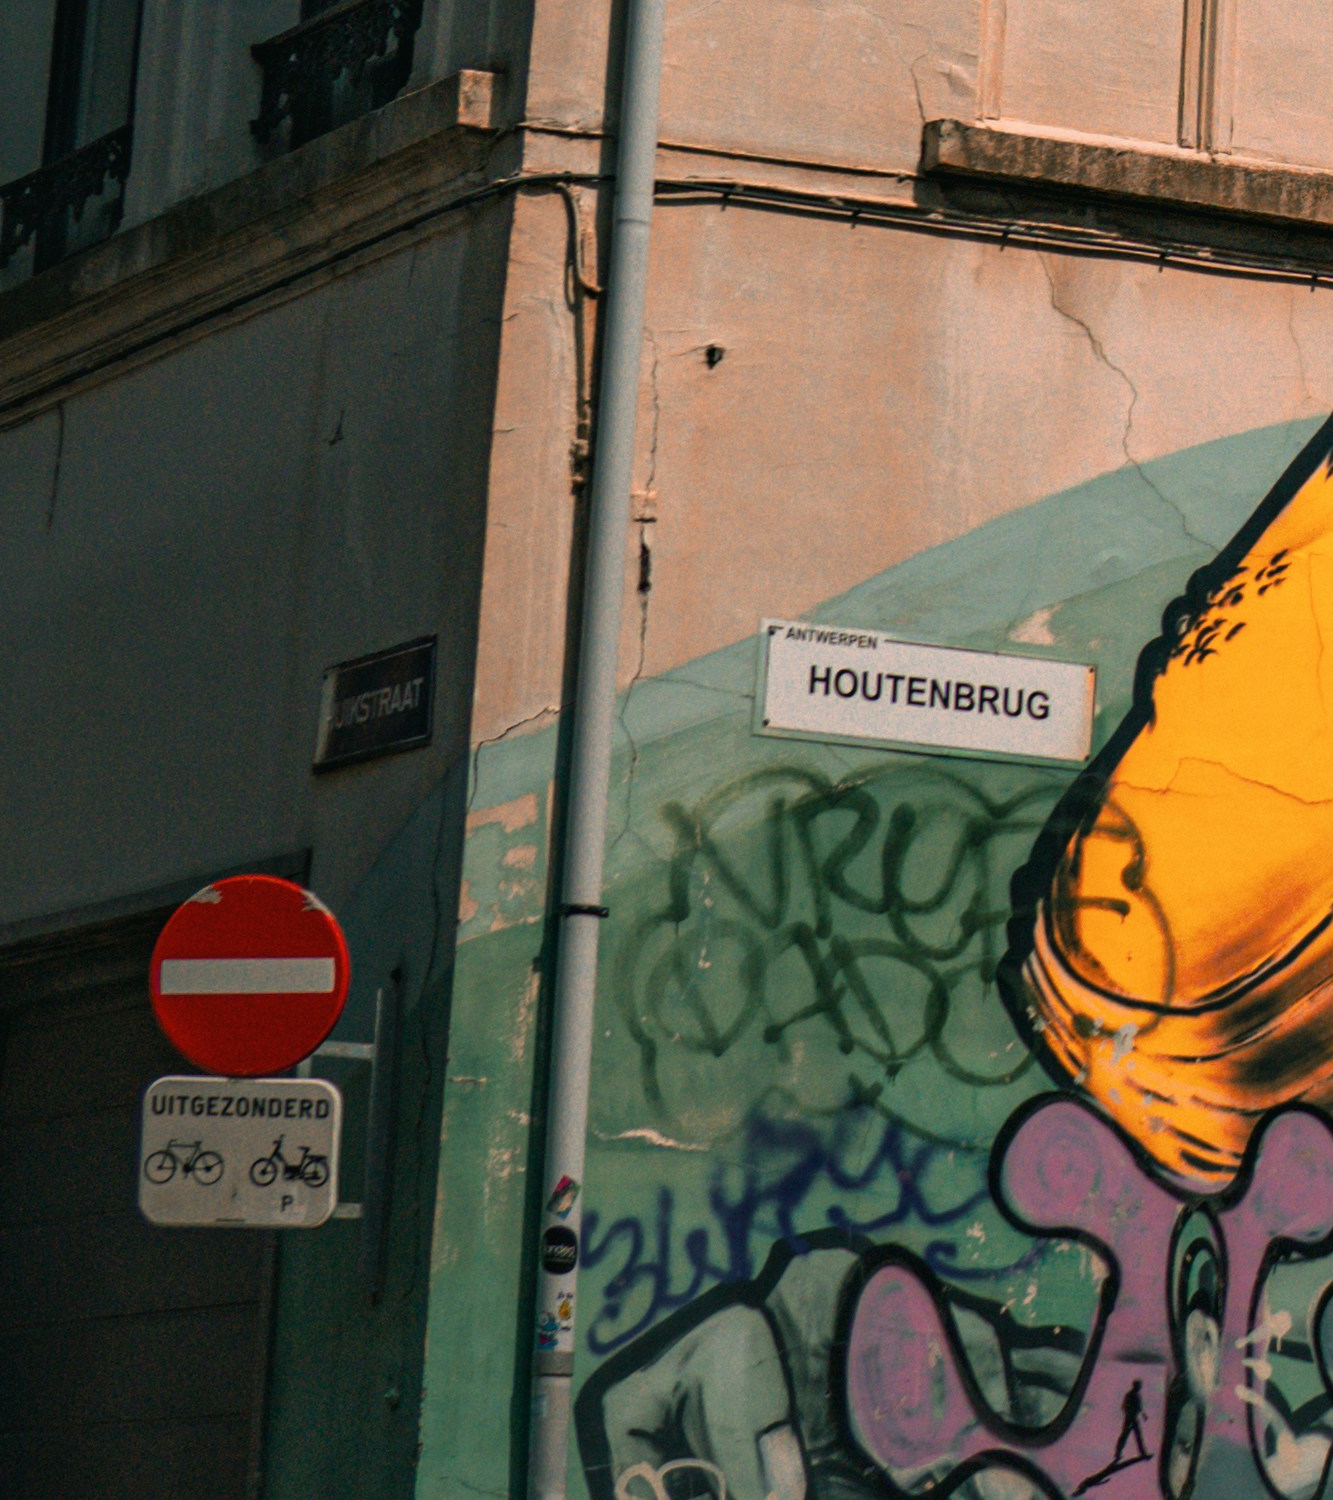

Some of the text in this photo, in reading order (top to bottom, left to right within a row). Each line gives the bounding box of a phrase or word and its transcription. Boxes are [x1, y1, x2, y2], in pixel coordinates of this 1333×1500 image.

[785, 625, 879, 650] ANTWERPEN
[809, 664, 1051, 720] HOUTENBRUG
[151, 1094, 330, 1118] UITGEZONDERD
